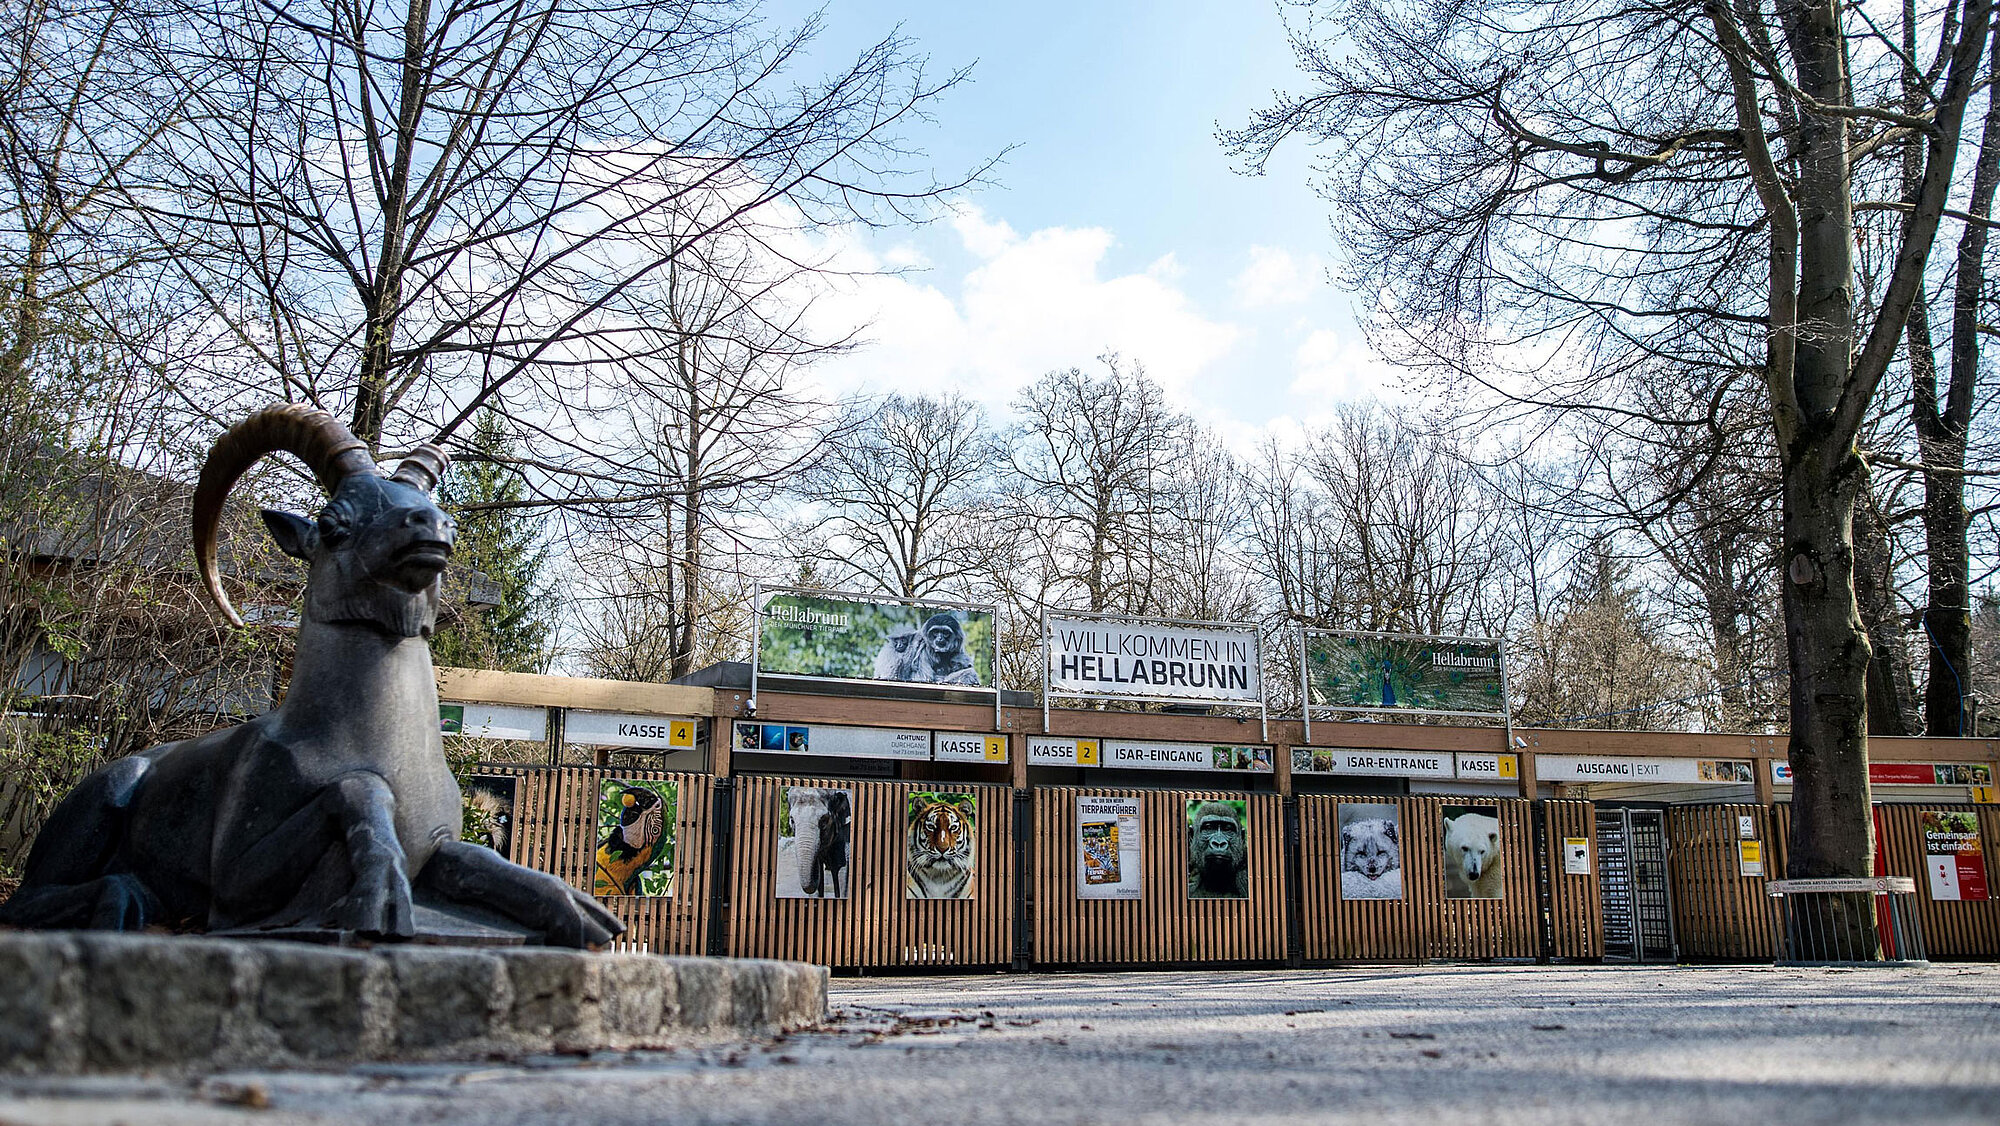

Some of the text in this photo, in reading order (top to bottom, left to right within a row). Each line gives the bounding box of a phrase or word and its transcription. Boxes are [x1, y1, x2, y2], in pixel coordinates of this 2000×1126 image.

[771, 605, 848, 625] Hellabrunn
[819, 625, 848, 633] TIERPARK
[1060, 629, 1246, 663] WILLKOMMEN IN
[1432, 652, 1494, 667] Hellabrunn
[1061, 655, 1247, 690] HELLABRUNN
[618, 723, 686, 739] KASSE 4
[891, 741, 927, 749] DURCHGANG
[941, 740, 998, 755] KASSE 3
[1033, 745, 1090, 759] KASSE 2
[1115, 748, 1203, 763] ISAR-EINGANG
[1347, 756, 1438, 770] ISAR-ENTRANCE
[1461, 760, 1510, 772] KASSE 1
[1576, 763, 1660, 775] AUSGANG EXIT
[1980, 786, 1988, 802] 1
[1081, 804, 1137, 815] TIERPARKFÜHRER
[1926, 830, 1977, 840] Gemeinsam
[1927, 841, 1976, 851] ist einfach.
